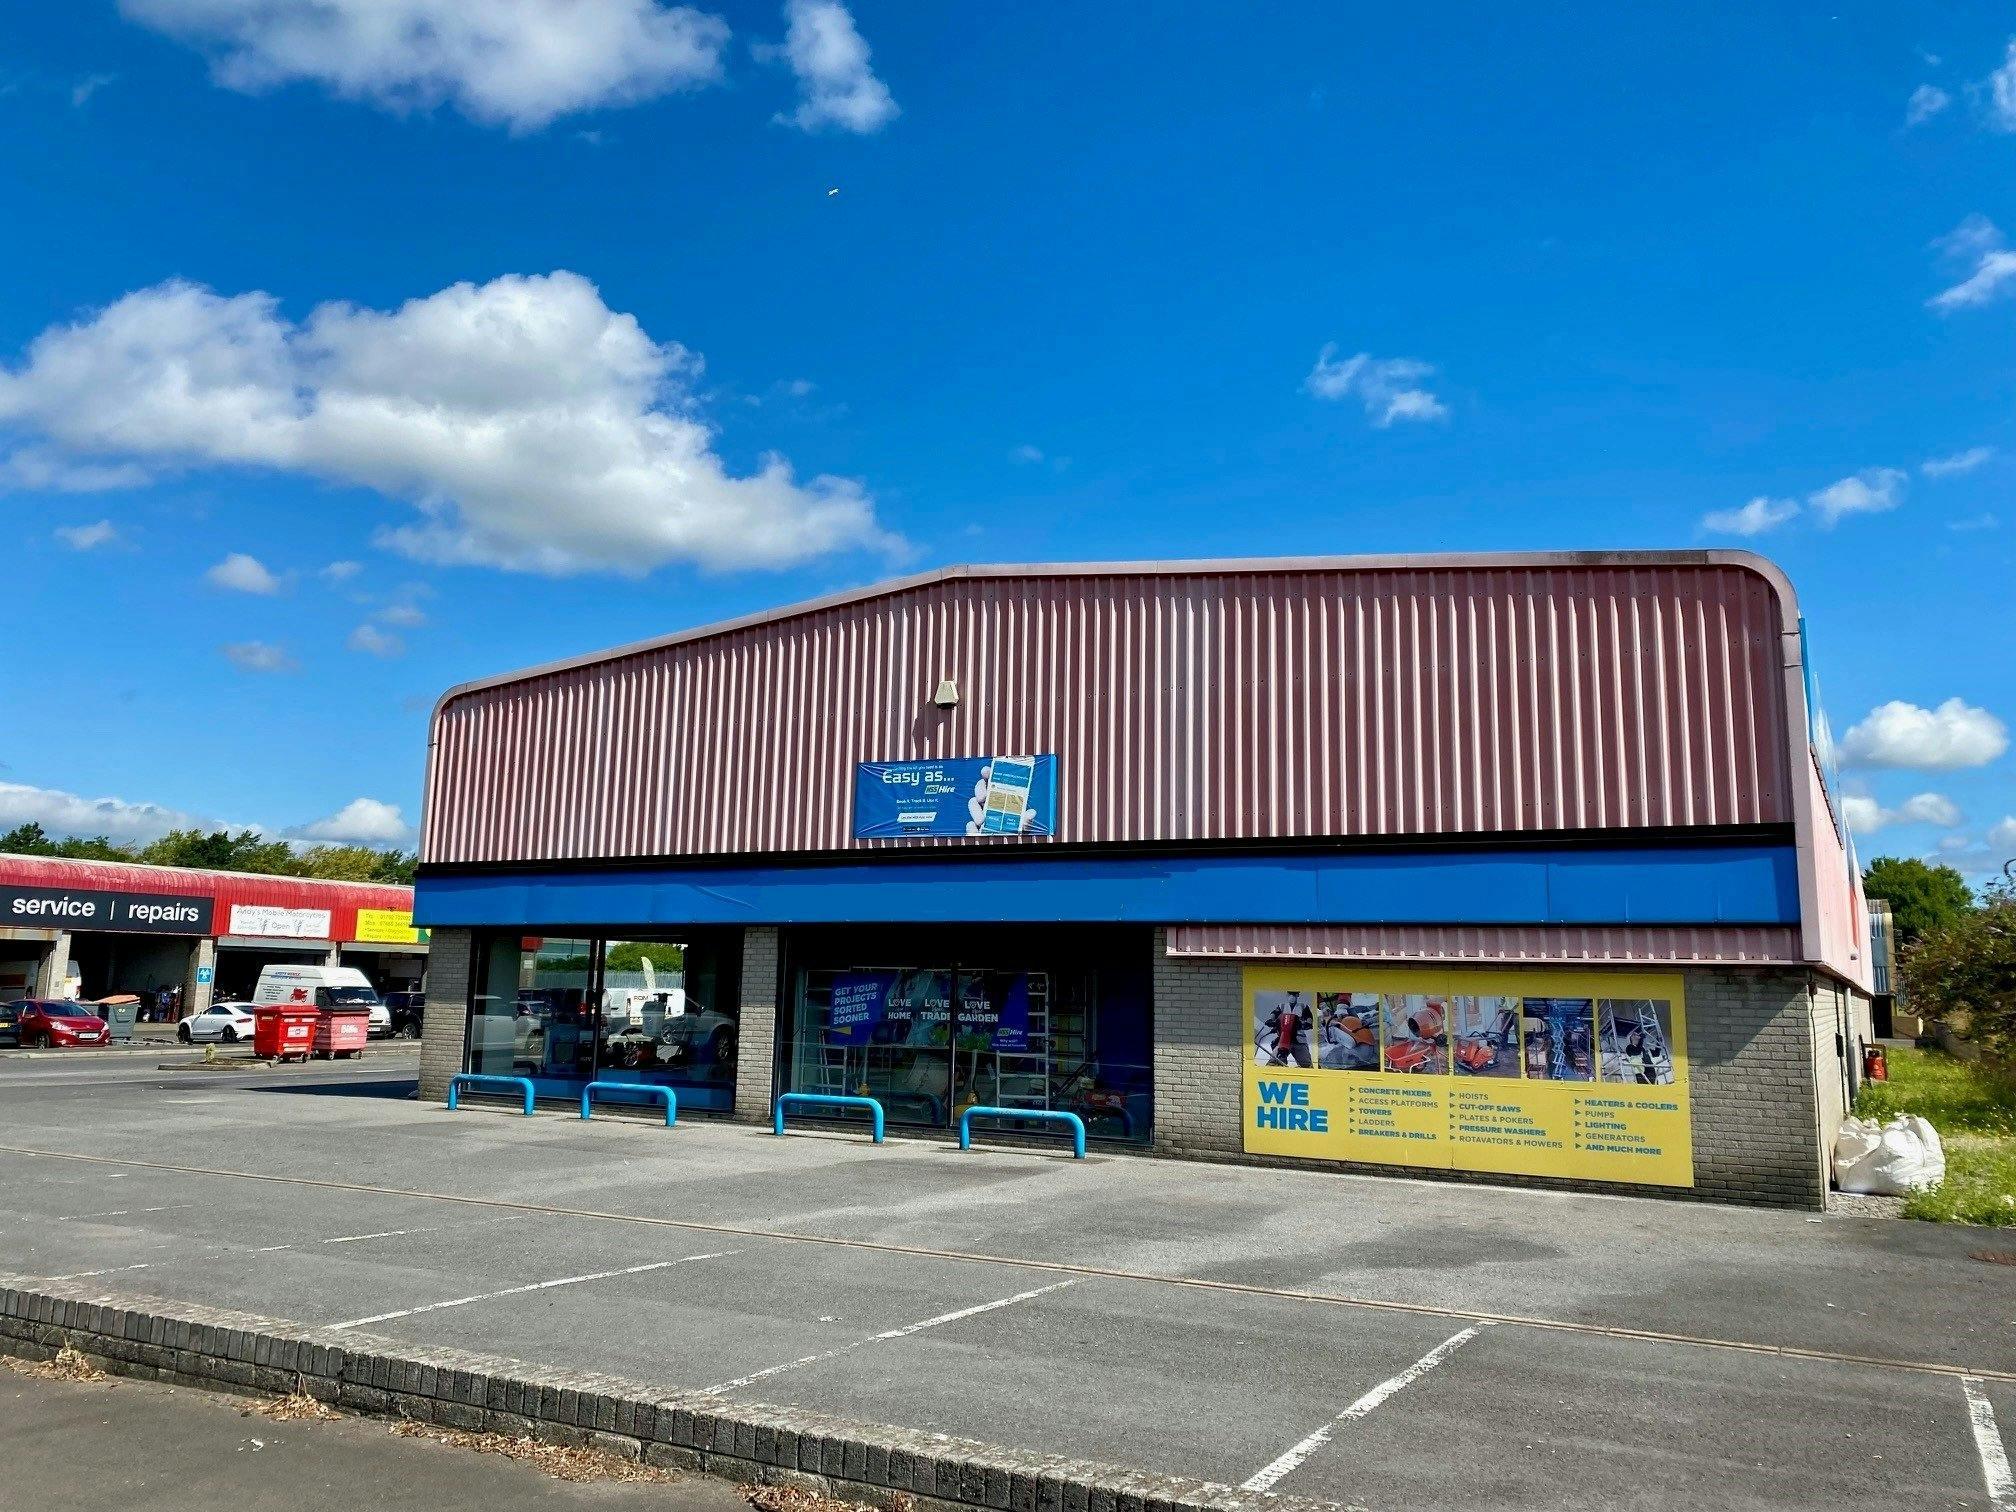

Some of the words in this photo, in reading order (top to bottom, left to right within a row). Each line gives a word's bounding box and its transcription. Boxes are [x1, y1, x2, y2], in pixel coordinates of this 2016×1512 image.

[882, 771, 920, 786] Easy
[925, 771, 954, 782] as...
[12, 896, 95, 917] service
[128, 903, 199, 923] repairs
[237, 908, 260, 916] Andy's
[284, 910, 327, 918] Motorcycles
[272, 921, 290, 930] Open
[835, 987, 851, 996] GET
[854, 983, 878, 993] YOUR
[834, 992, 877, 1006] PROJECTS
[925, 999, 950, 1007] LOVE
[834, 1003, 867, 1015] SORTED
[965, 1001, 990, 1009] LOVE
[958, 1014, 998, 1022] GARDEN
[1258, 1082, 1309, 1106] WE
[1358, 1087, 1400, 1096] CONCRETE
[1359, 1098, 1389, 1106] ACCESS
[1391, 1100, 1438, 1108] PLATFORMS
[1585, 1100, 1625, 1108] HEATERS
[1636, 1102, 1678, 1111] COOLERS
[1358, 1108, 1392, 1116] TOWERS
[1257, 1106, 1328, 1132] HIRE
[1359, 1118, 1395, 1126] LADDERS
[1459, 1125, 1501, 1134] PRESSURE
[1504, 1128, 1546, 1136] WASHERS
[1585, 1121, 1627, 1130] LIGHTING
[1358, 1129, 1400, 1138] BREAKERS
[1409, 1132, 1436, 1140] DRILLS
[1585, 1133, 1646, 1143] GENERATORS
[1459, 1136, 1513, 1145] ROTAVATORS
[1524, 1140, 1562, 1148] MOWERS
[1607, 1145, 1633, 1153] MUCH
[1635, 1147, 1662, 1155] MORE
